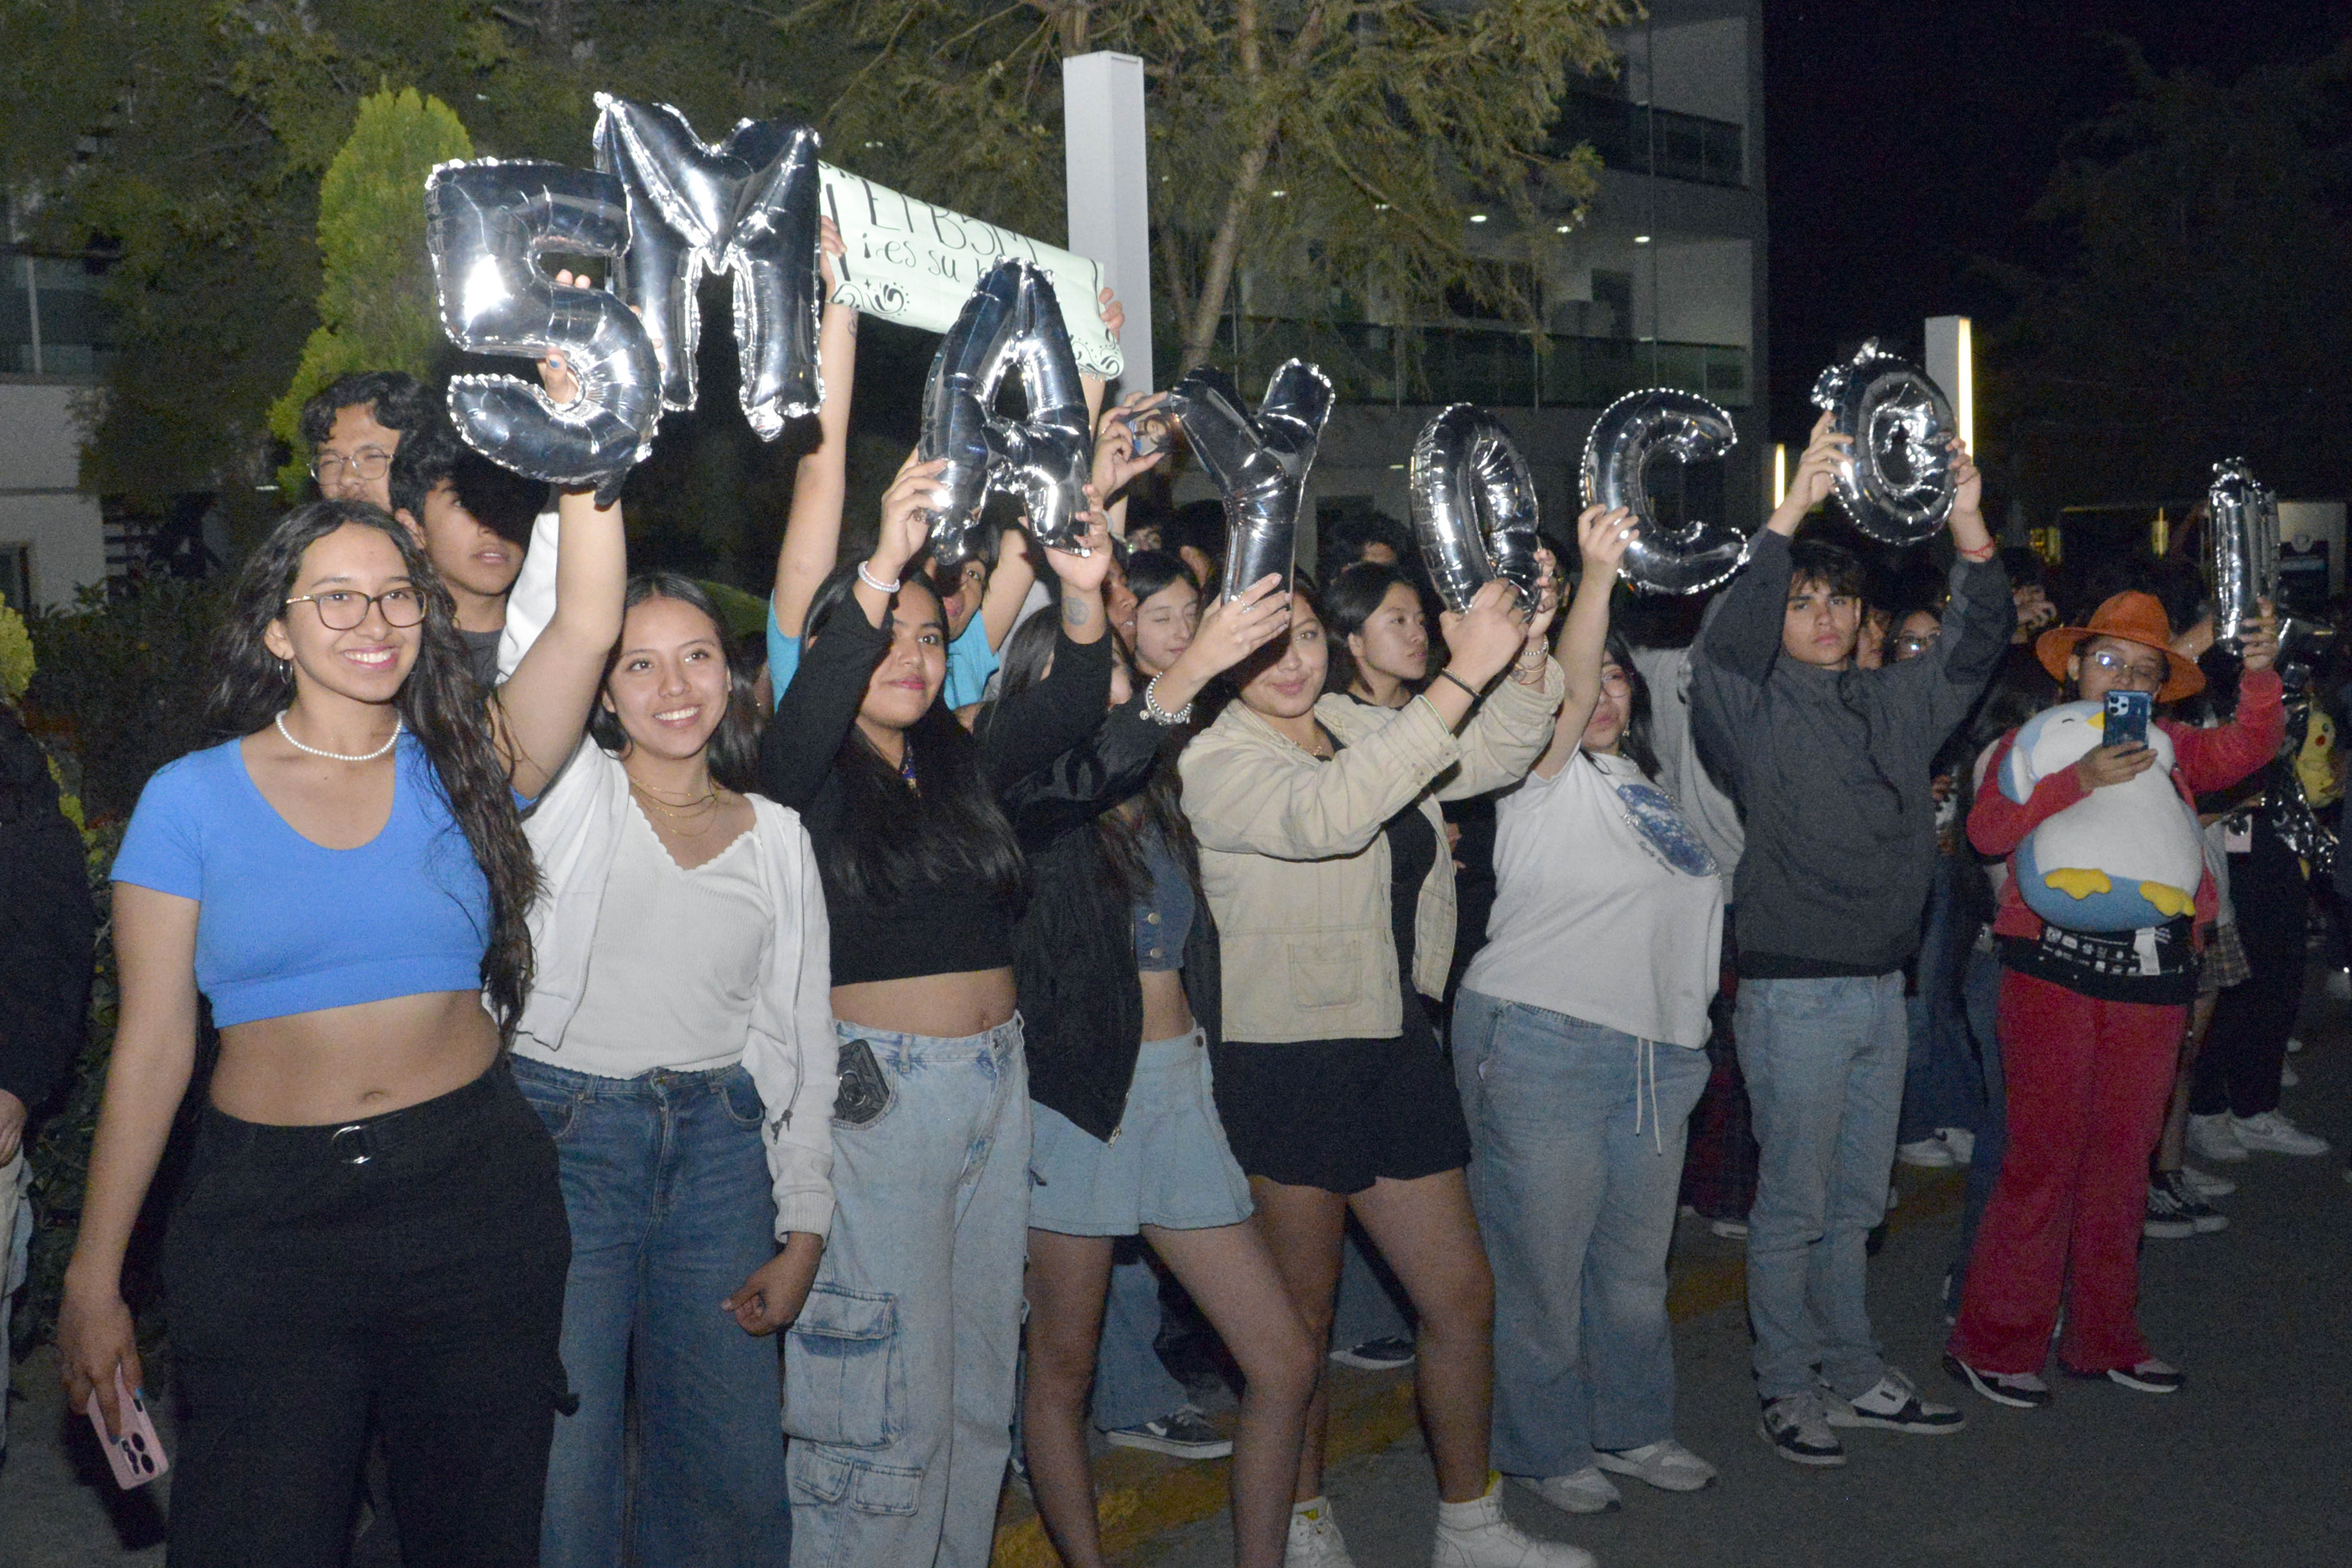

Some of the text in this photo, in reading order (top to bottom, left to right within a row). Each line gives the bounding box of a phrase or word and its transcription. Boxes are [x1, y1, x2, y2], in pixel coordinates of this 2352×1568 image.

[593, 91, 826, 443] M
[918, 254, 1093, 565] A
[1168, 358, 1336, 607] Y
[1579, 387, 1751, 595] C
[927, 249, 961, 283] su
